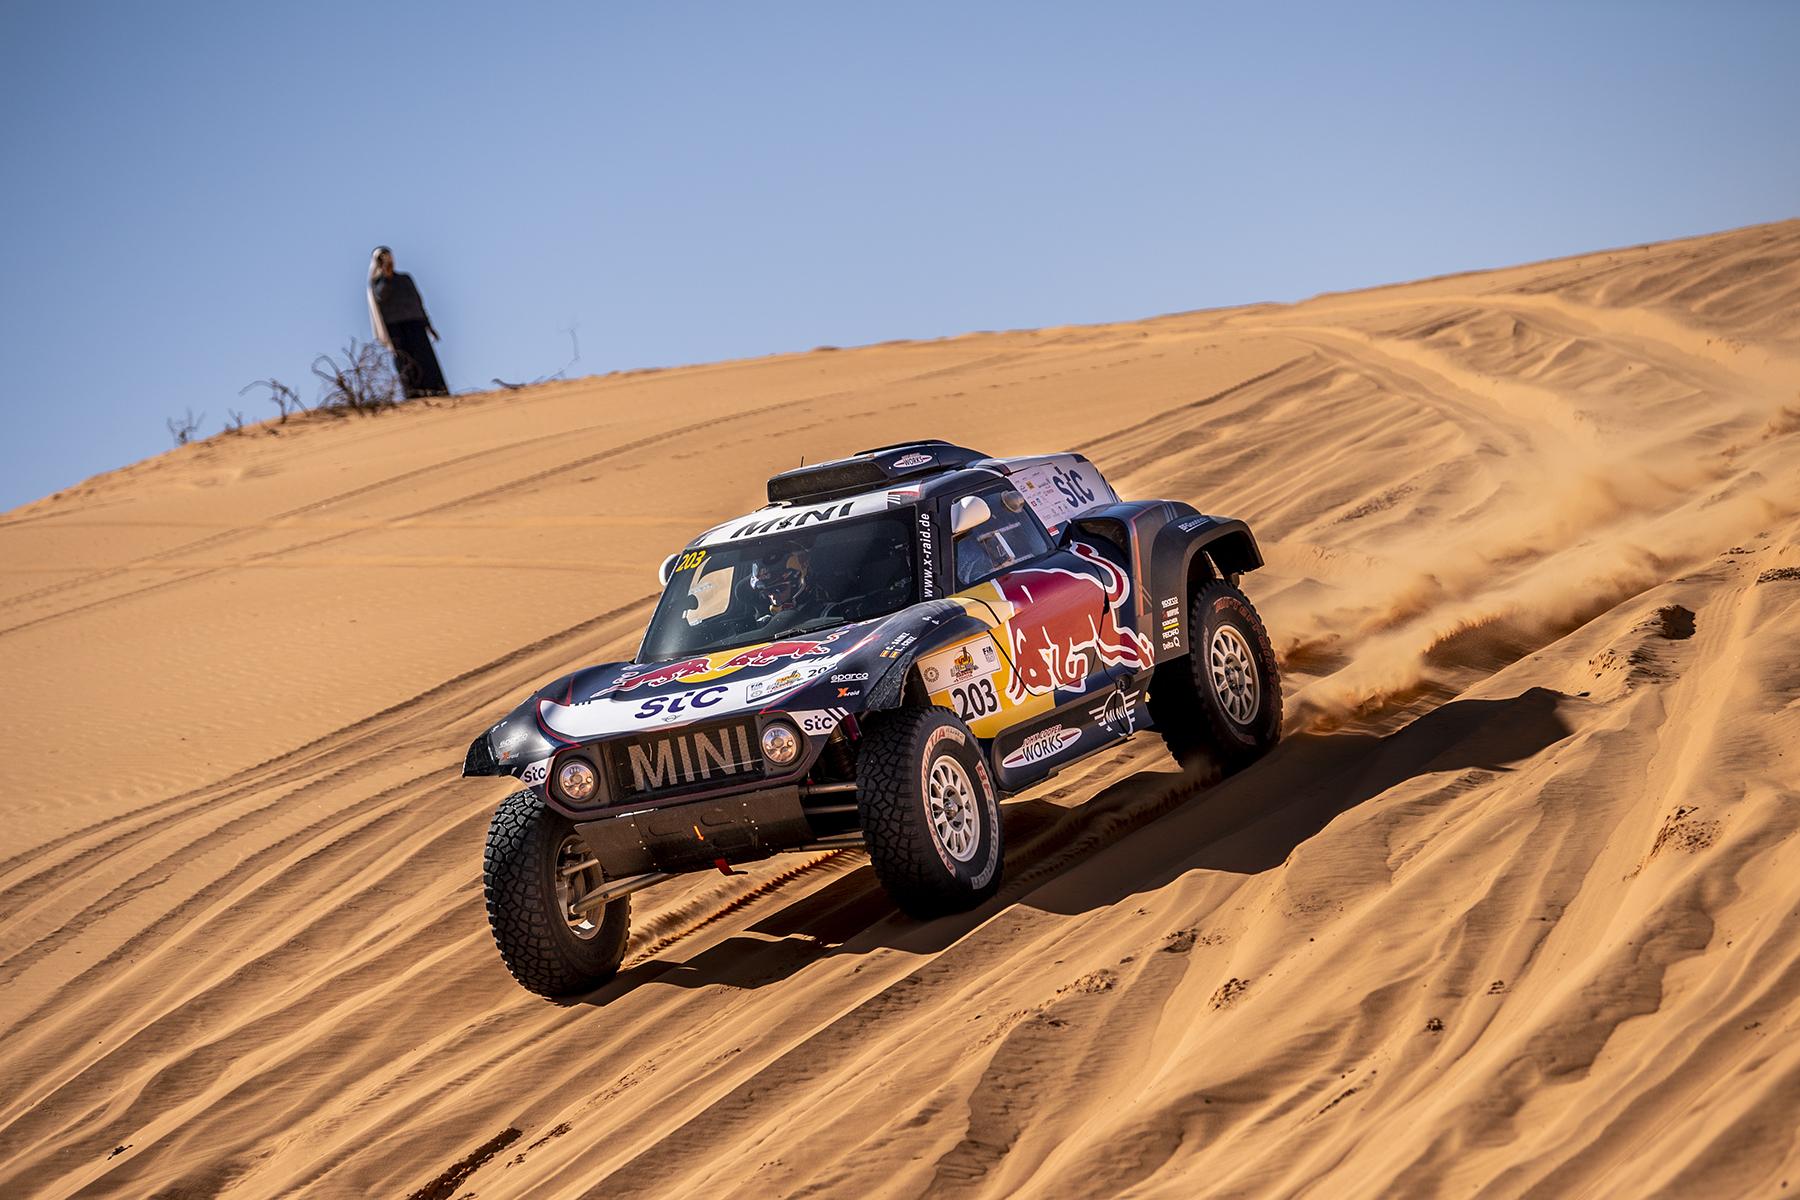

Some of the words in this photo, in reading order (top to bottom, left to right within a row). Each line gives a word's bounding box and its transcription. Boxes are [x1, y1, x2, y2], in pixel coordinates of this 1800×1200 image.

[730, 502, 855, 539] MINI
[675, 550, 707, 573] 203
[919, 513, 933, 598] www.x-raid.de
[831, 672, 869, 683] sparco
[952, 679, 998, 721] 203
[1105, 705, 1126, 723] MINI
[1022, 734, 1040, 747] JOHN
[1038, 724, 1062, 741] COOPER
[1022, 733, 1063, 762] WORKS
[628, 725, 753, 791] MINI
